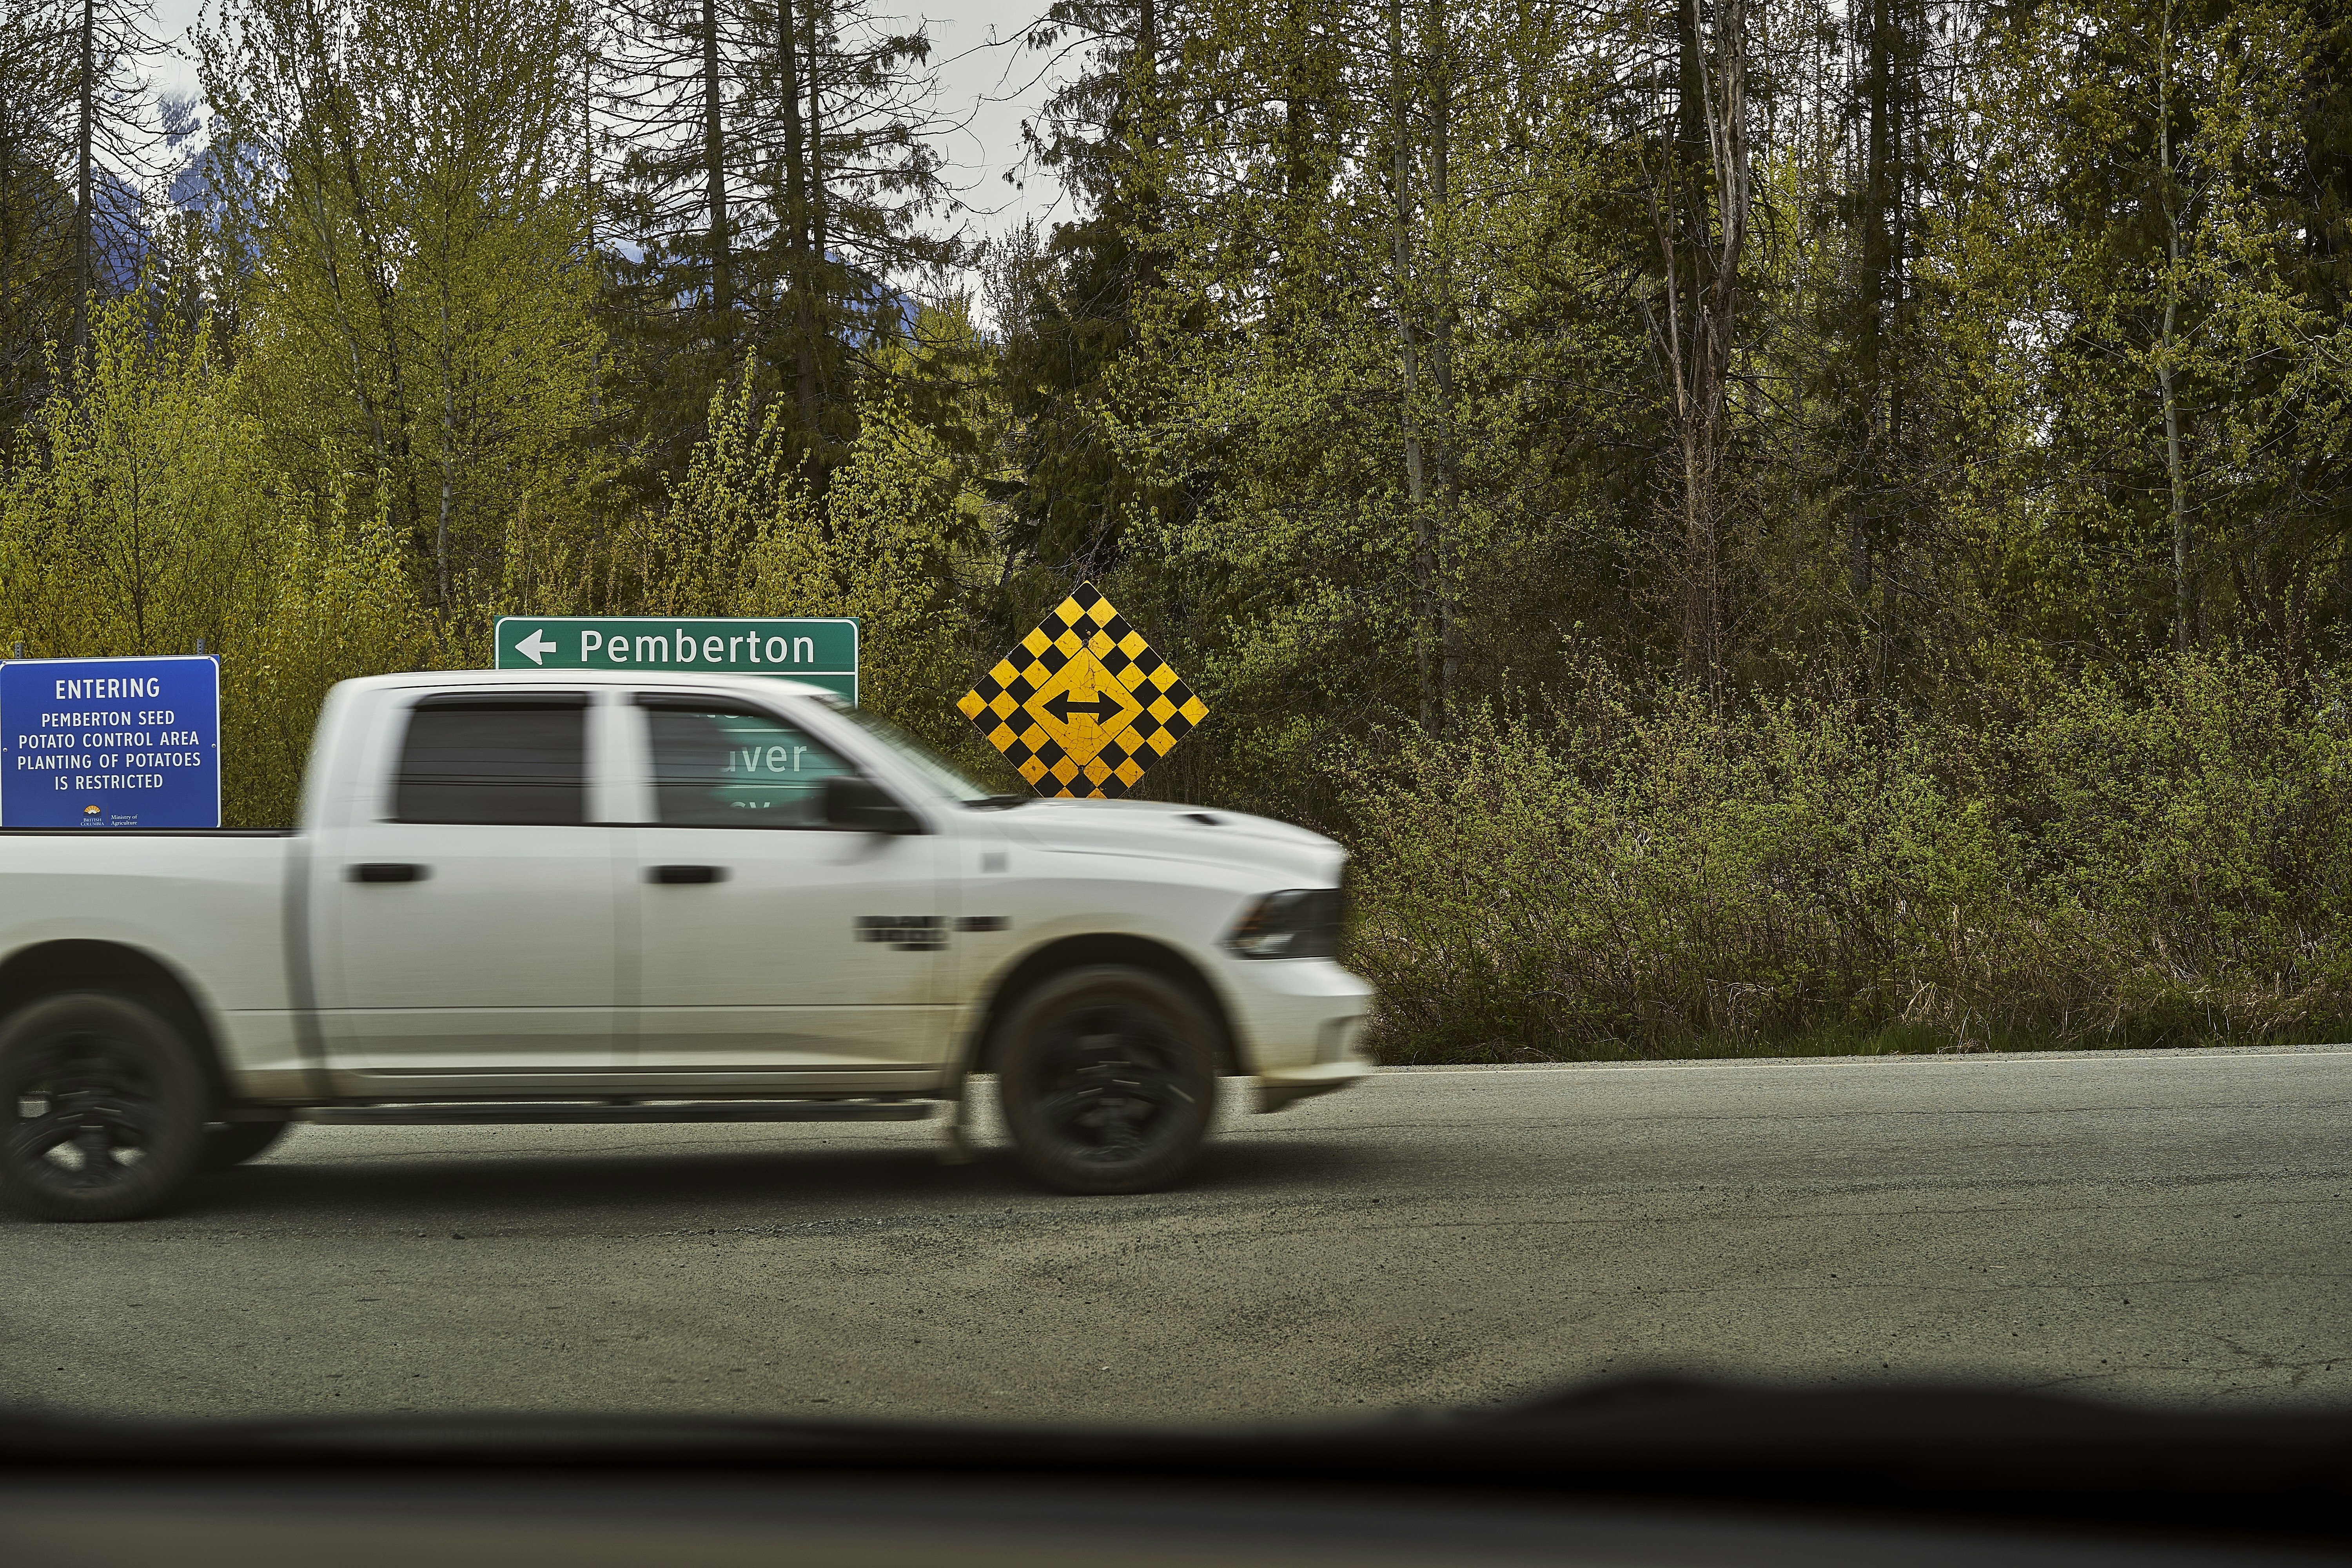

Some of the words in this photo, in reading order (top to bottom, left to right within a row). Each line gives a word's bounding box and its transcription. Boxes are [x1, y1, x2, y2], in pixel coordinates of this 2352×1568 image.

[581, 628, 814, 663] Pemberton
[56, 677, 160, 700] ENTERING
[42, 711, 131, 728] PEMBERTON
[138, 710, 175, 725] SEED
[19, 733, 75, 749] POTATO
[82, 732, 153, 748] CONTROL
[159, 731, 200, 746] AREA
[17, 755, 92, 770] PLANTING
[99, 753, 119, 768] OF
[126, 751, 201, 768] POTATOES
[54, 776, 68, 791] IS
[75, 774, 163, 790] RESTRICTED
